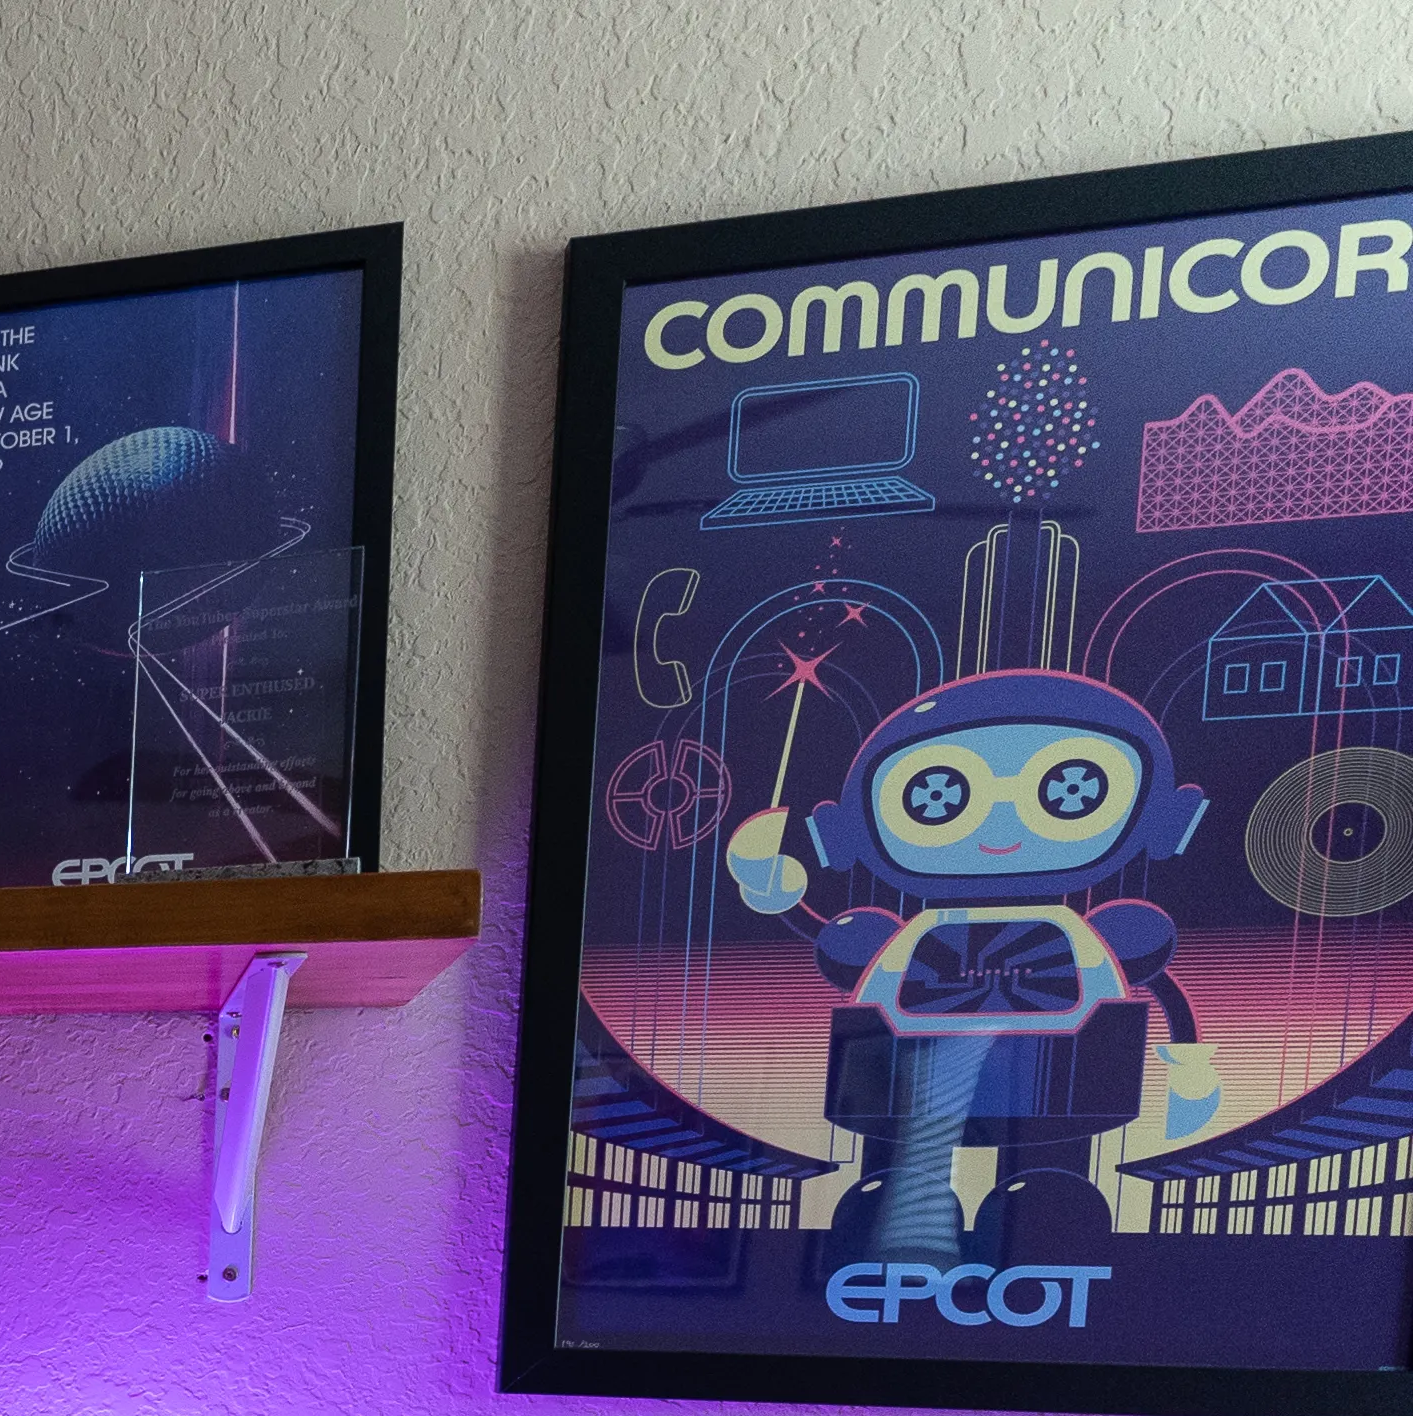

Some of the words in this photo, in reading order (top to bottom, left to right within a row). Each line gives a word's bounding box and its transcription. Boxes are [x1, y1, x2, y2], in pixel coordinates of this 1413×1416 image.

[643, 219, 1413, 370] COMMUNICOR
[0, 325, 35, 347] THE
[9, 401, 54, 424] AGE
[64, 425, 79, 445] 1,
[231, 677, 316, 697] ENTHUSED
[189, 786, 220, 801] going
[254, 781, 277, 793] and
[825, 1262, 1112, 1327] EPCOT
